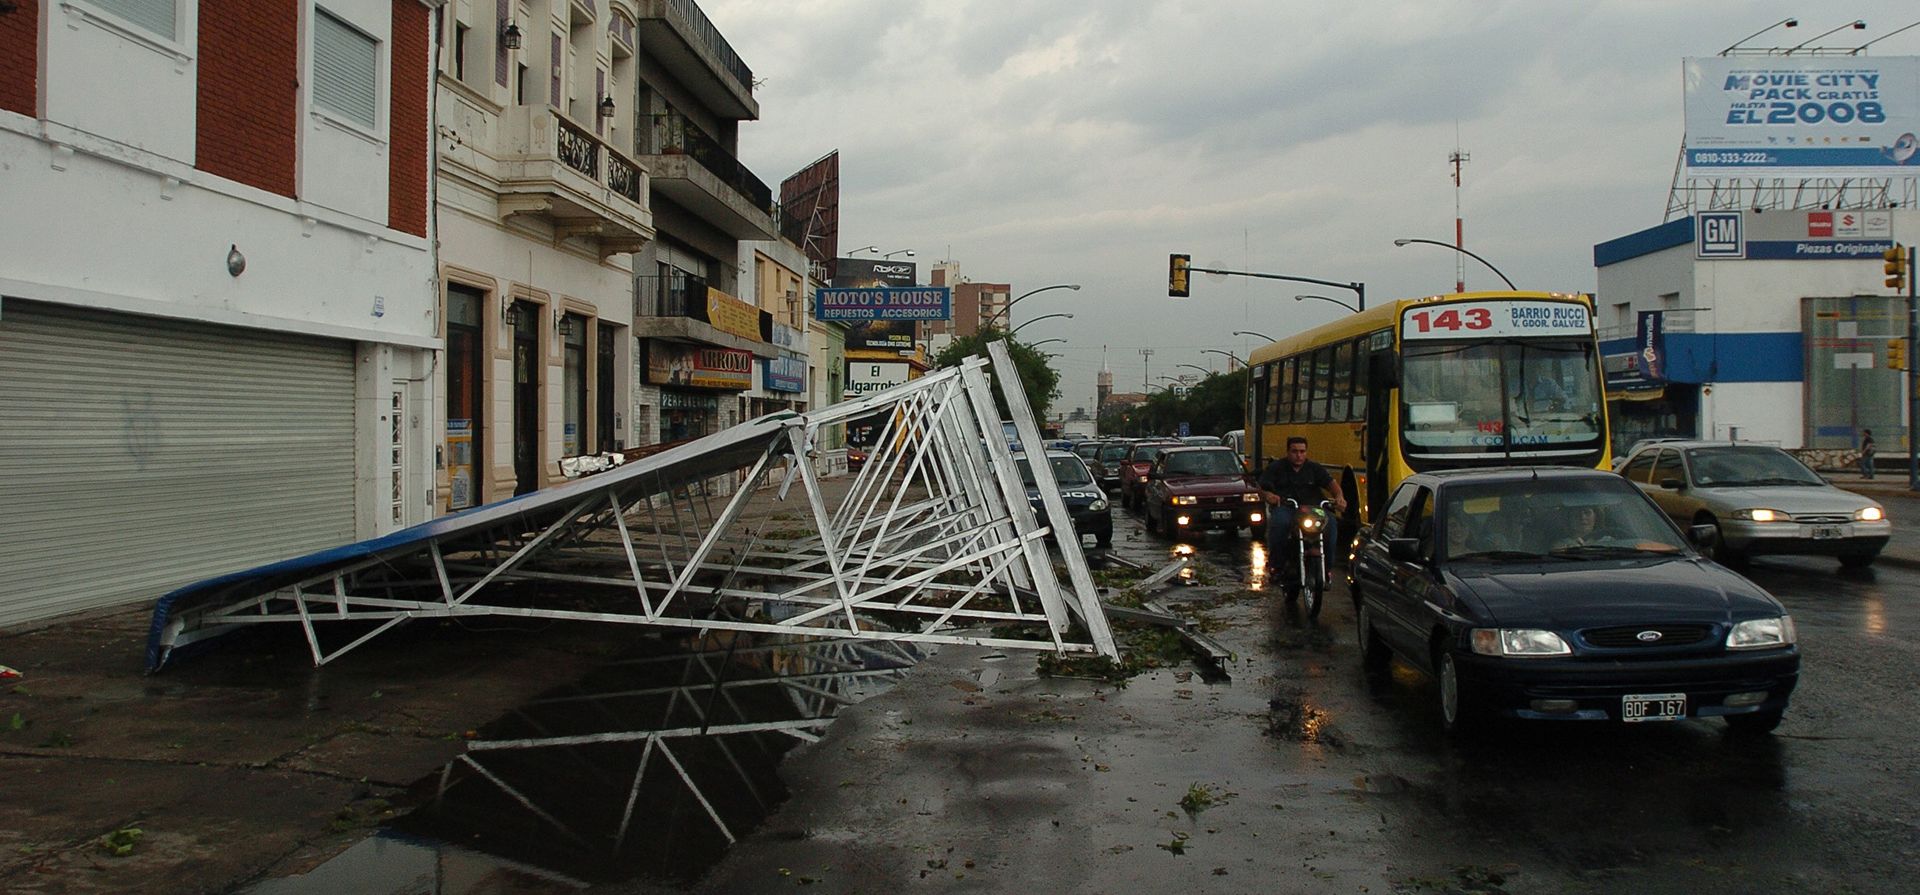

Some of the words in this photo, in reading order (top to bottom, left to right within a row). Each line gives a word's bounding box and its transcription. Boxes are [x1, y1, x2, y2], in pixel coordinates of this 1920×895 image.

[1723, 74, 1810, 91] MOVIE
[1816, 74, 1879, 89] CITY
[1749, 88, 1811, 100] PACK
[1817, 91, 1879, 99] GRATIS
[1726, 110, 1763, 124] EL
[1767, 102, 1886, 124] 2008
[1695, 153, 1767, 163] 0810-333-2222
[1705, 219, 1735, 242] GM
[1796, 243, 1832, 254] Piezas
[1834, 243, 1891, 255] Originales
[823, 291, 884, 305] MOTO'S
[889, 291, 943, 305] HOUSE
[824, 309, 875, 318] REPUESTOS
[881, 309, 943, 318] ACCESORIOS
[1511, 307, 1550, 319] BARRIO
[1554, 308, 1585, 319] RUCCI
[1412, 308, 1493, 332] 143
[1523, 319, 1549, 328] GDOR.
[1552, 319, 1586, 328] GALVEZ
[700, 350, 750, 372] ARROYO
[871, 365, 880, 377] El
[1659, 700, 1684, 715] 167
